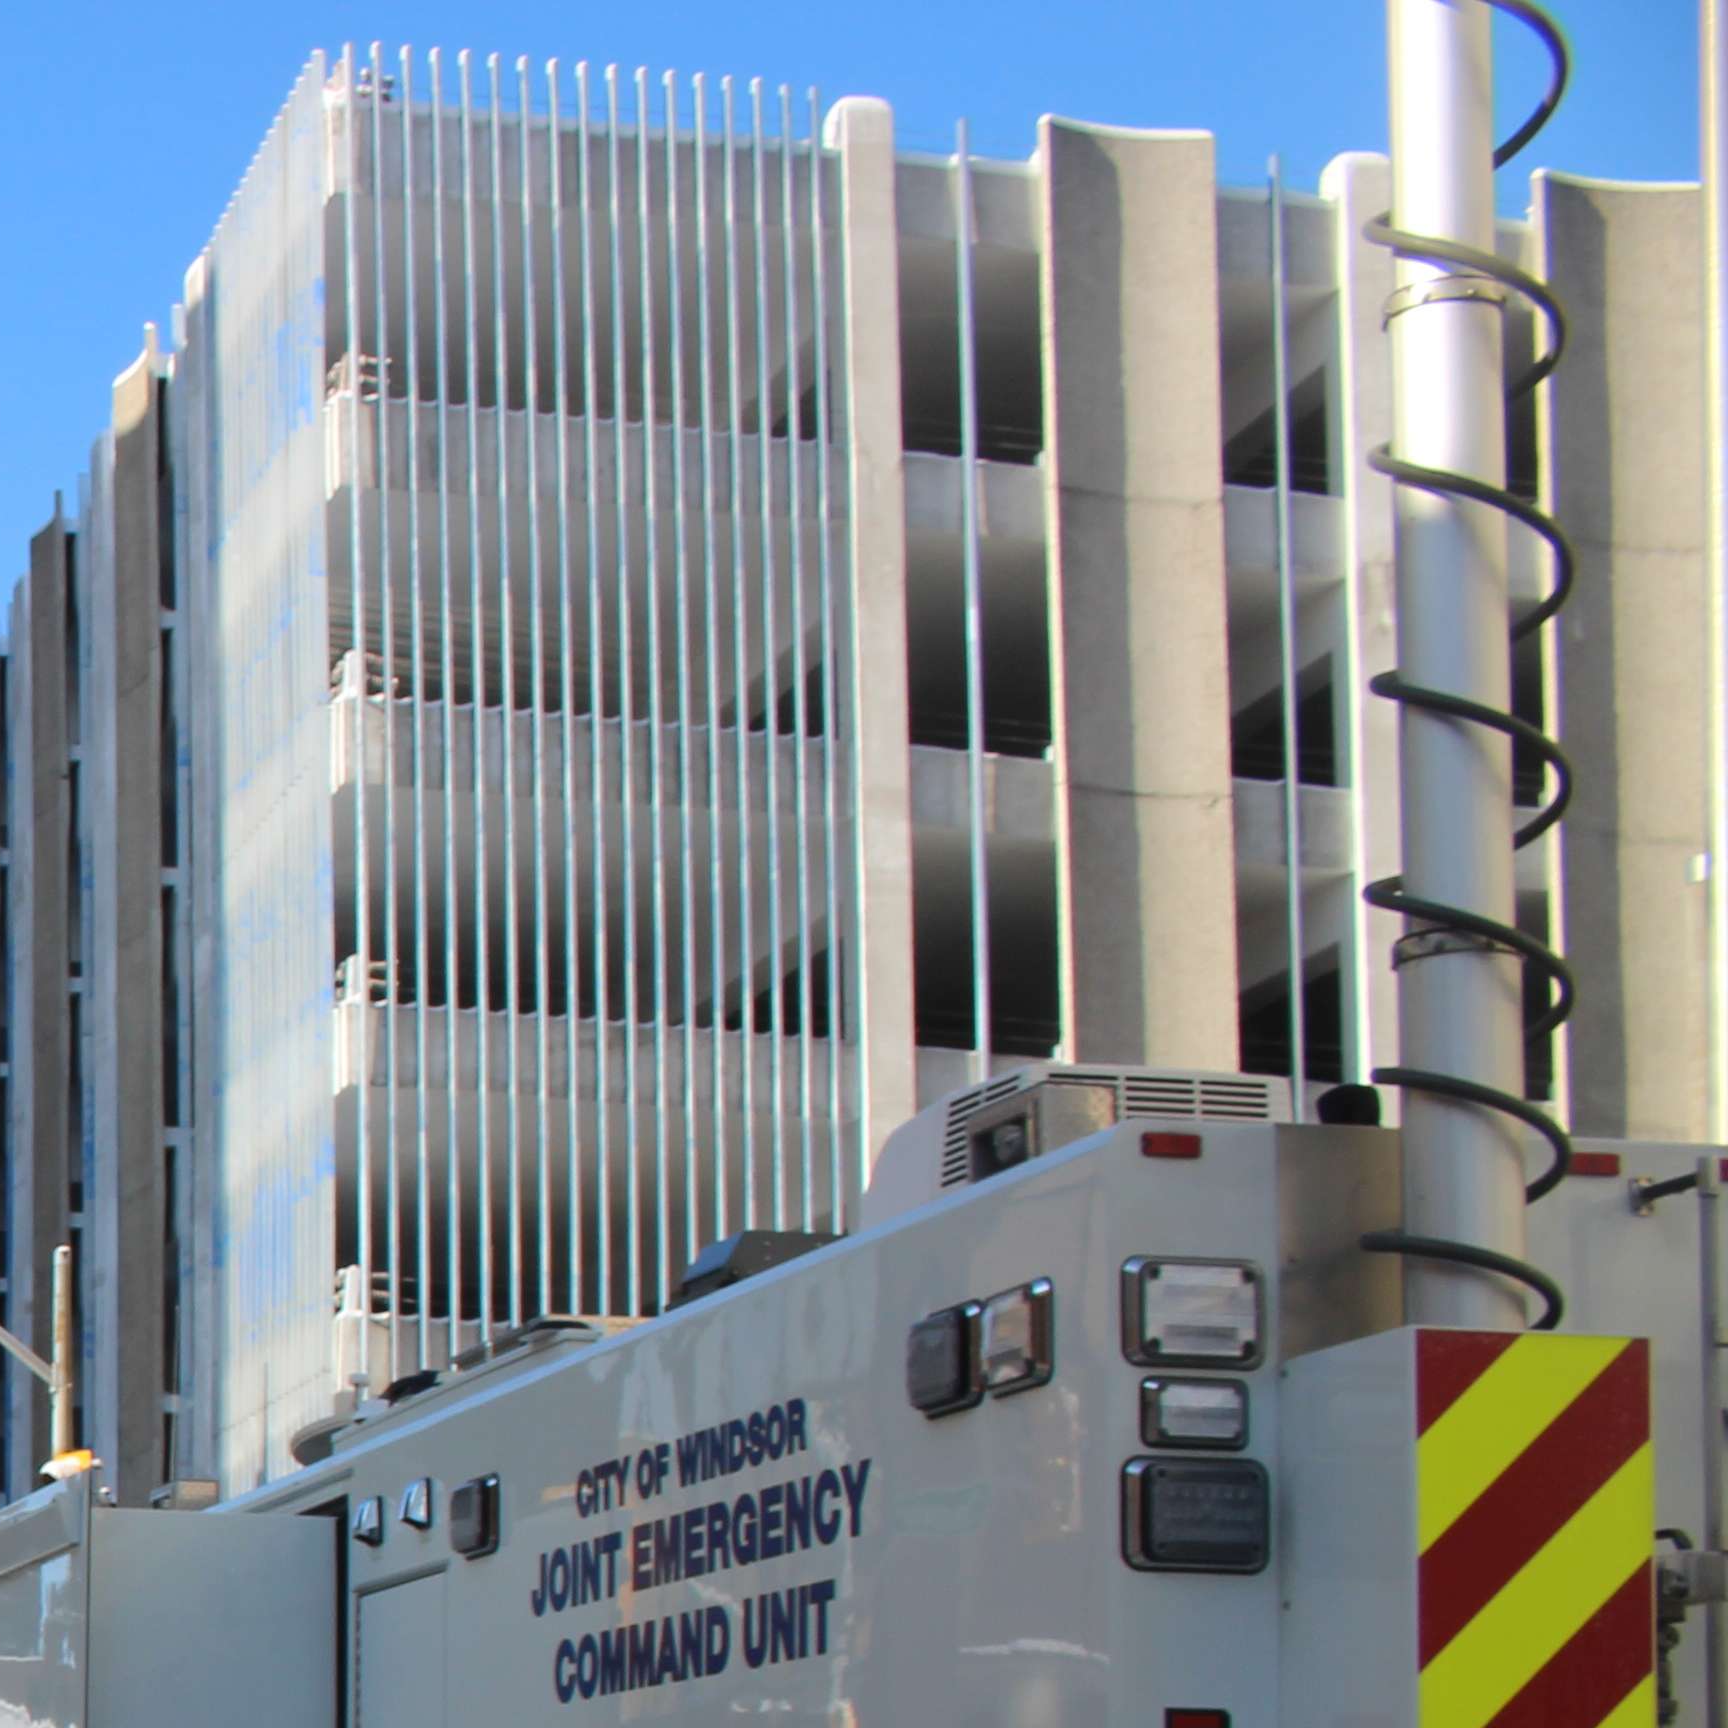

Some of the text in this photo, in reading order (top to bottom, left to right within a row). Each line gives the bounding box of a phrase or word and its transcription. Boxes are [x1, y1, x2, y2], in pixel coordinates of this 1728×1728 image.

[576, 1398, 806, 1518] CITY OF WINDSOR
[531, 1458, 872, 1617] JOINT EMERGENCY
[555, 1579, 835, 1703] COMMAND UNIT
